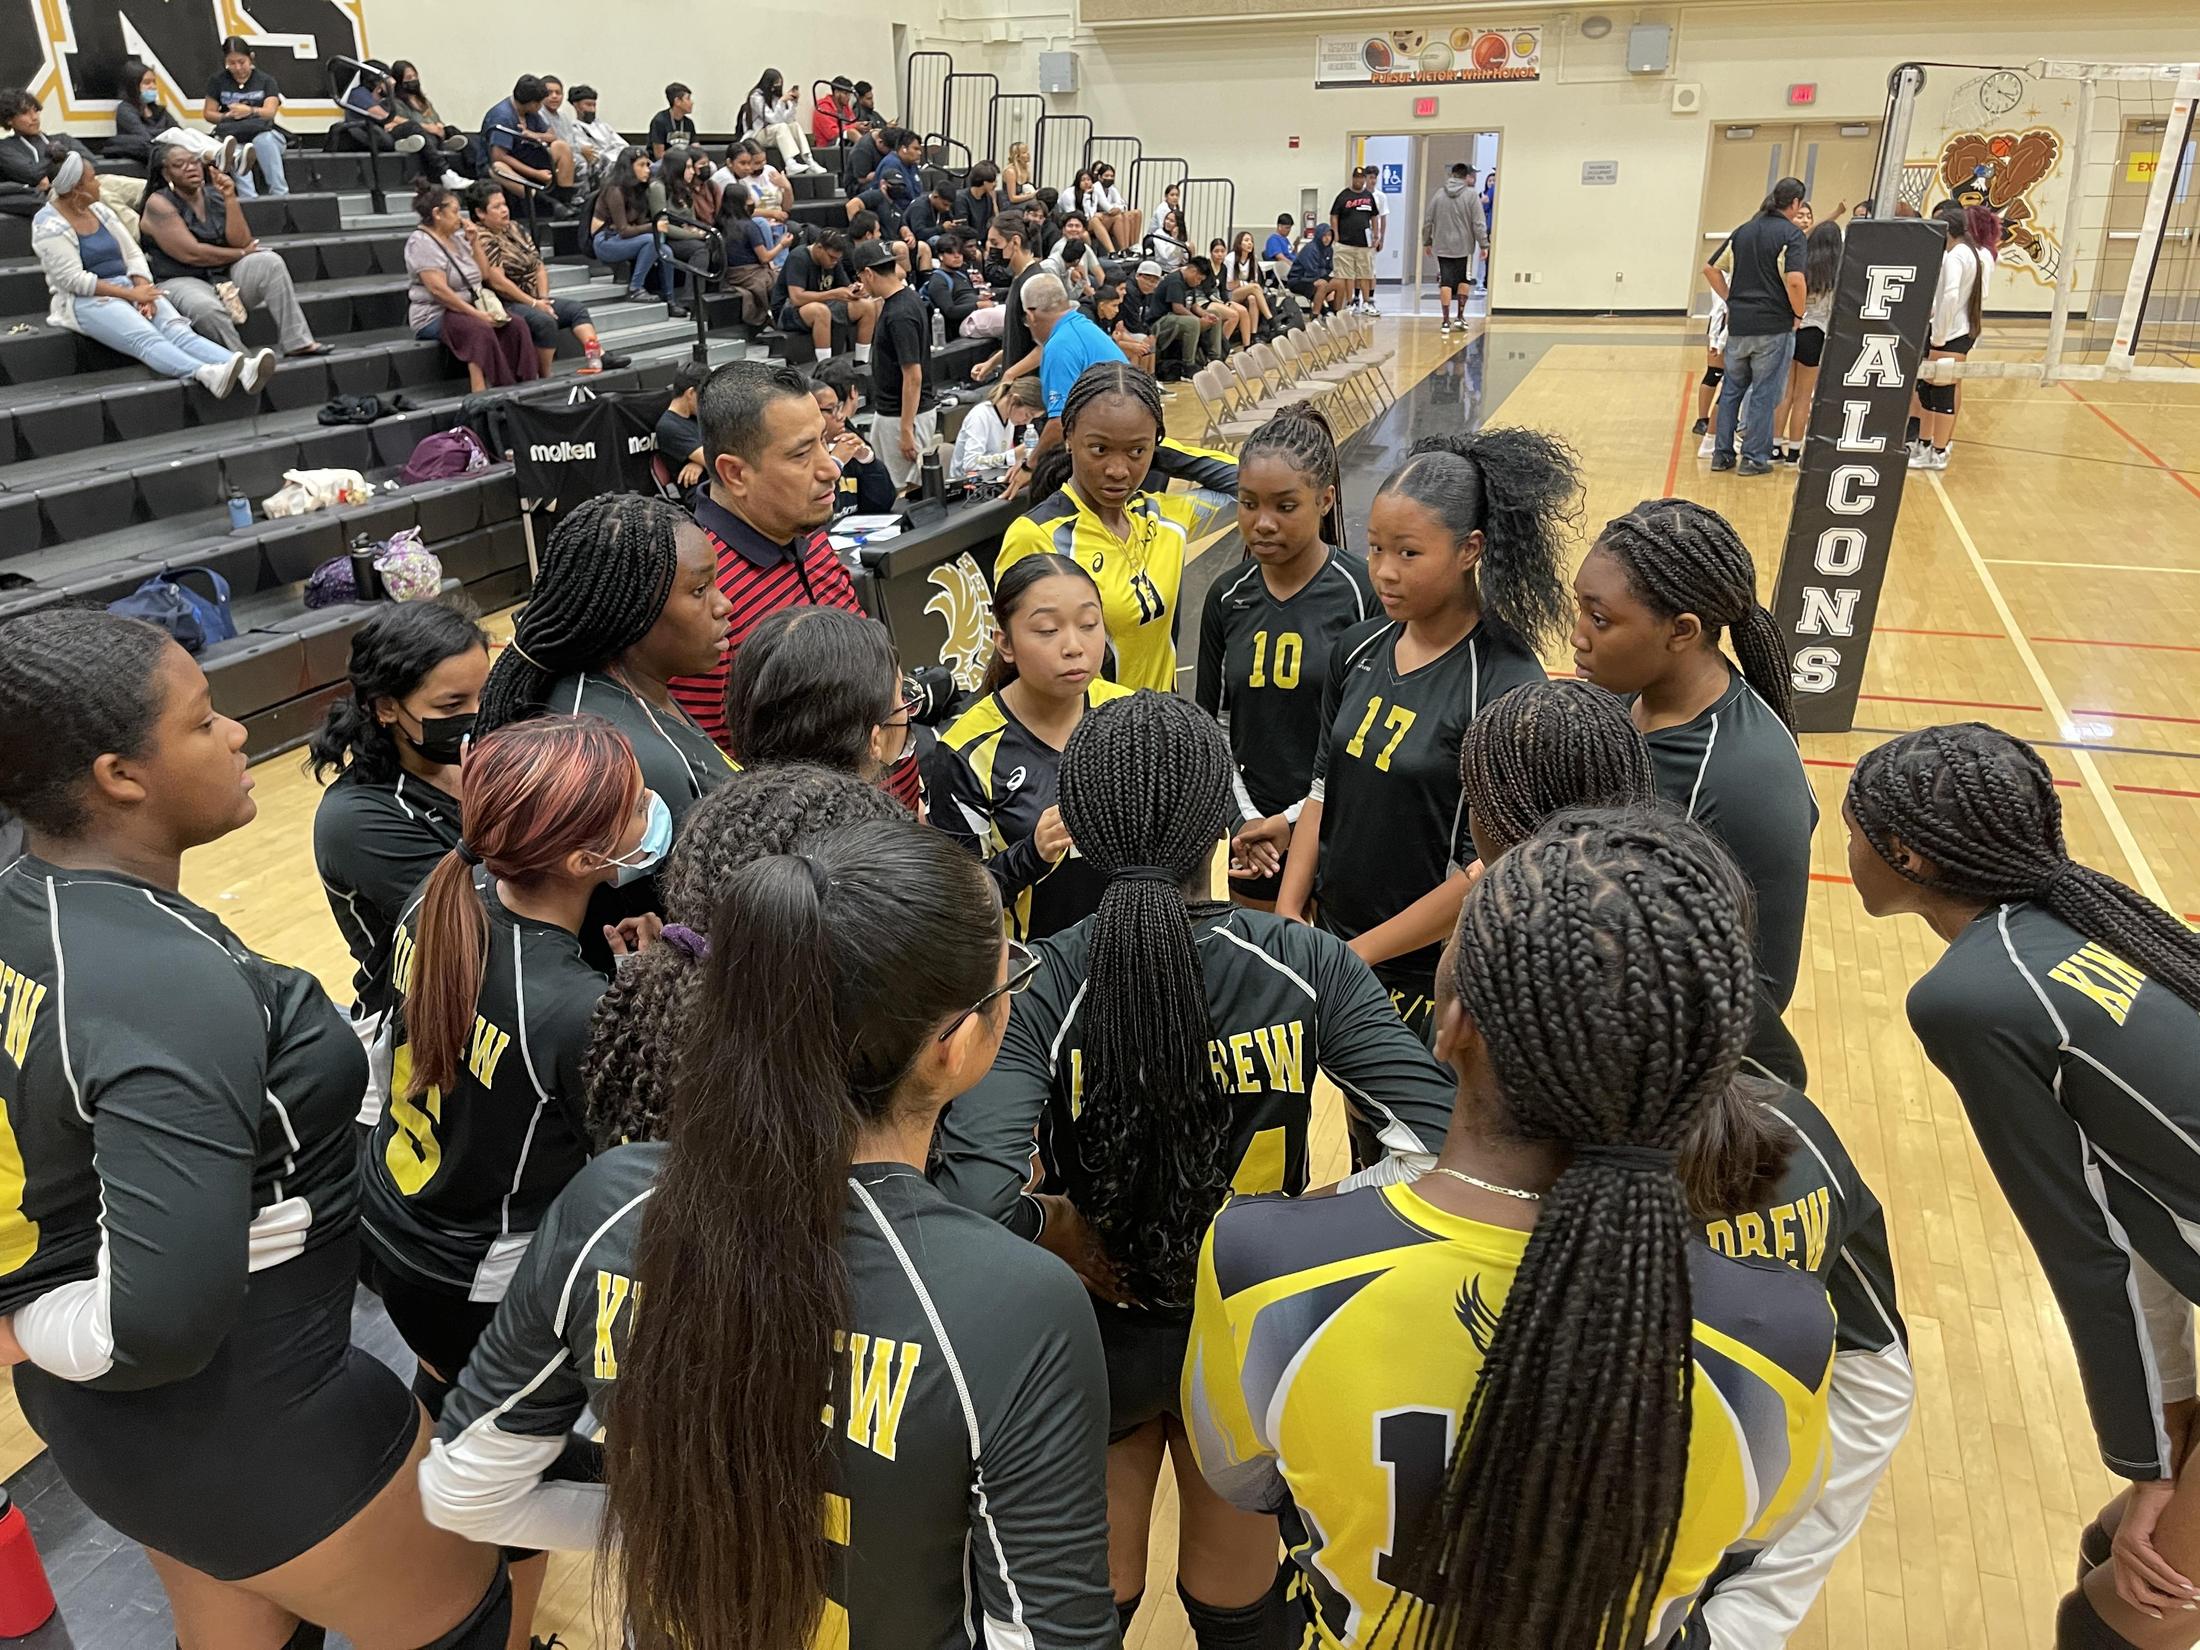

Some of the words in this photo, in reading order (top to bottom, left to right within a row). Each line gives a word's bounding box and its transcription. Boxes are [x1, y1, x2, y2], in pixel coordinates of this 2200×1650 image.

[1371, 72, 1412, 84] PURSUE
[1416, 70, 1459, 82] VICTORY
[1492, 66, 1537, 79] HONOR
[2137, 161, 2158, 172] EXI
[530, 441, 597, 463] molten
[1791, 265, 1917, 693] FALCONS
[1249, 630, 1303, 690] 10
[1345, 695, 1417, 773] 17
[2047, 940, 2147, 1027] KIN
[1206, 1020, 1306, 1095] REW
